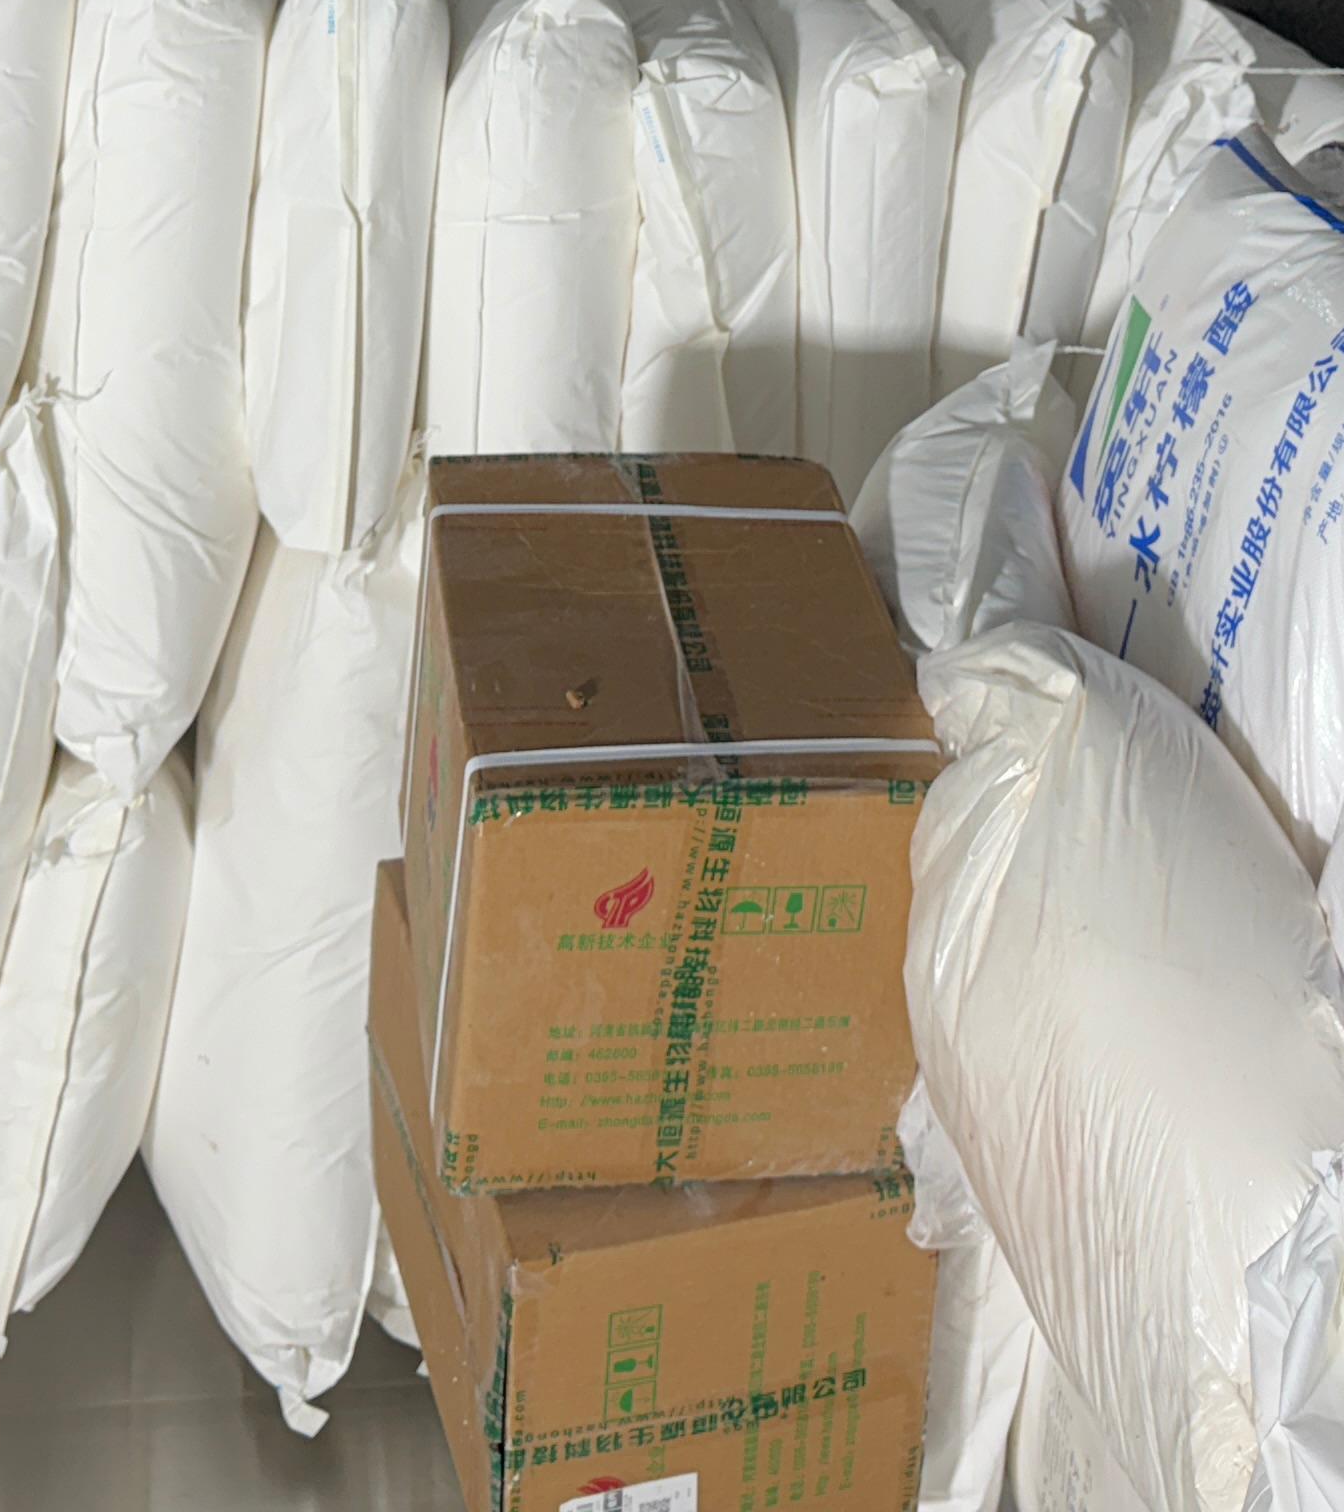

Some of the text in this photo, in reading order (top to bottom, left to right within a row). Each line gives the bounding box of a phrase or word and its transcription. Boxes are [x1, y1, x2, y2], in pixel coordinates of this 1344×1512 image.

[1105, 348, 1179, 540] YINGXUAN
[1118, 279, 1260, 660] 一水柠檬酸
